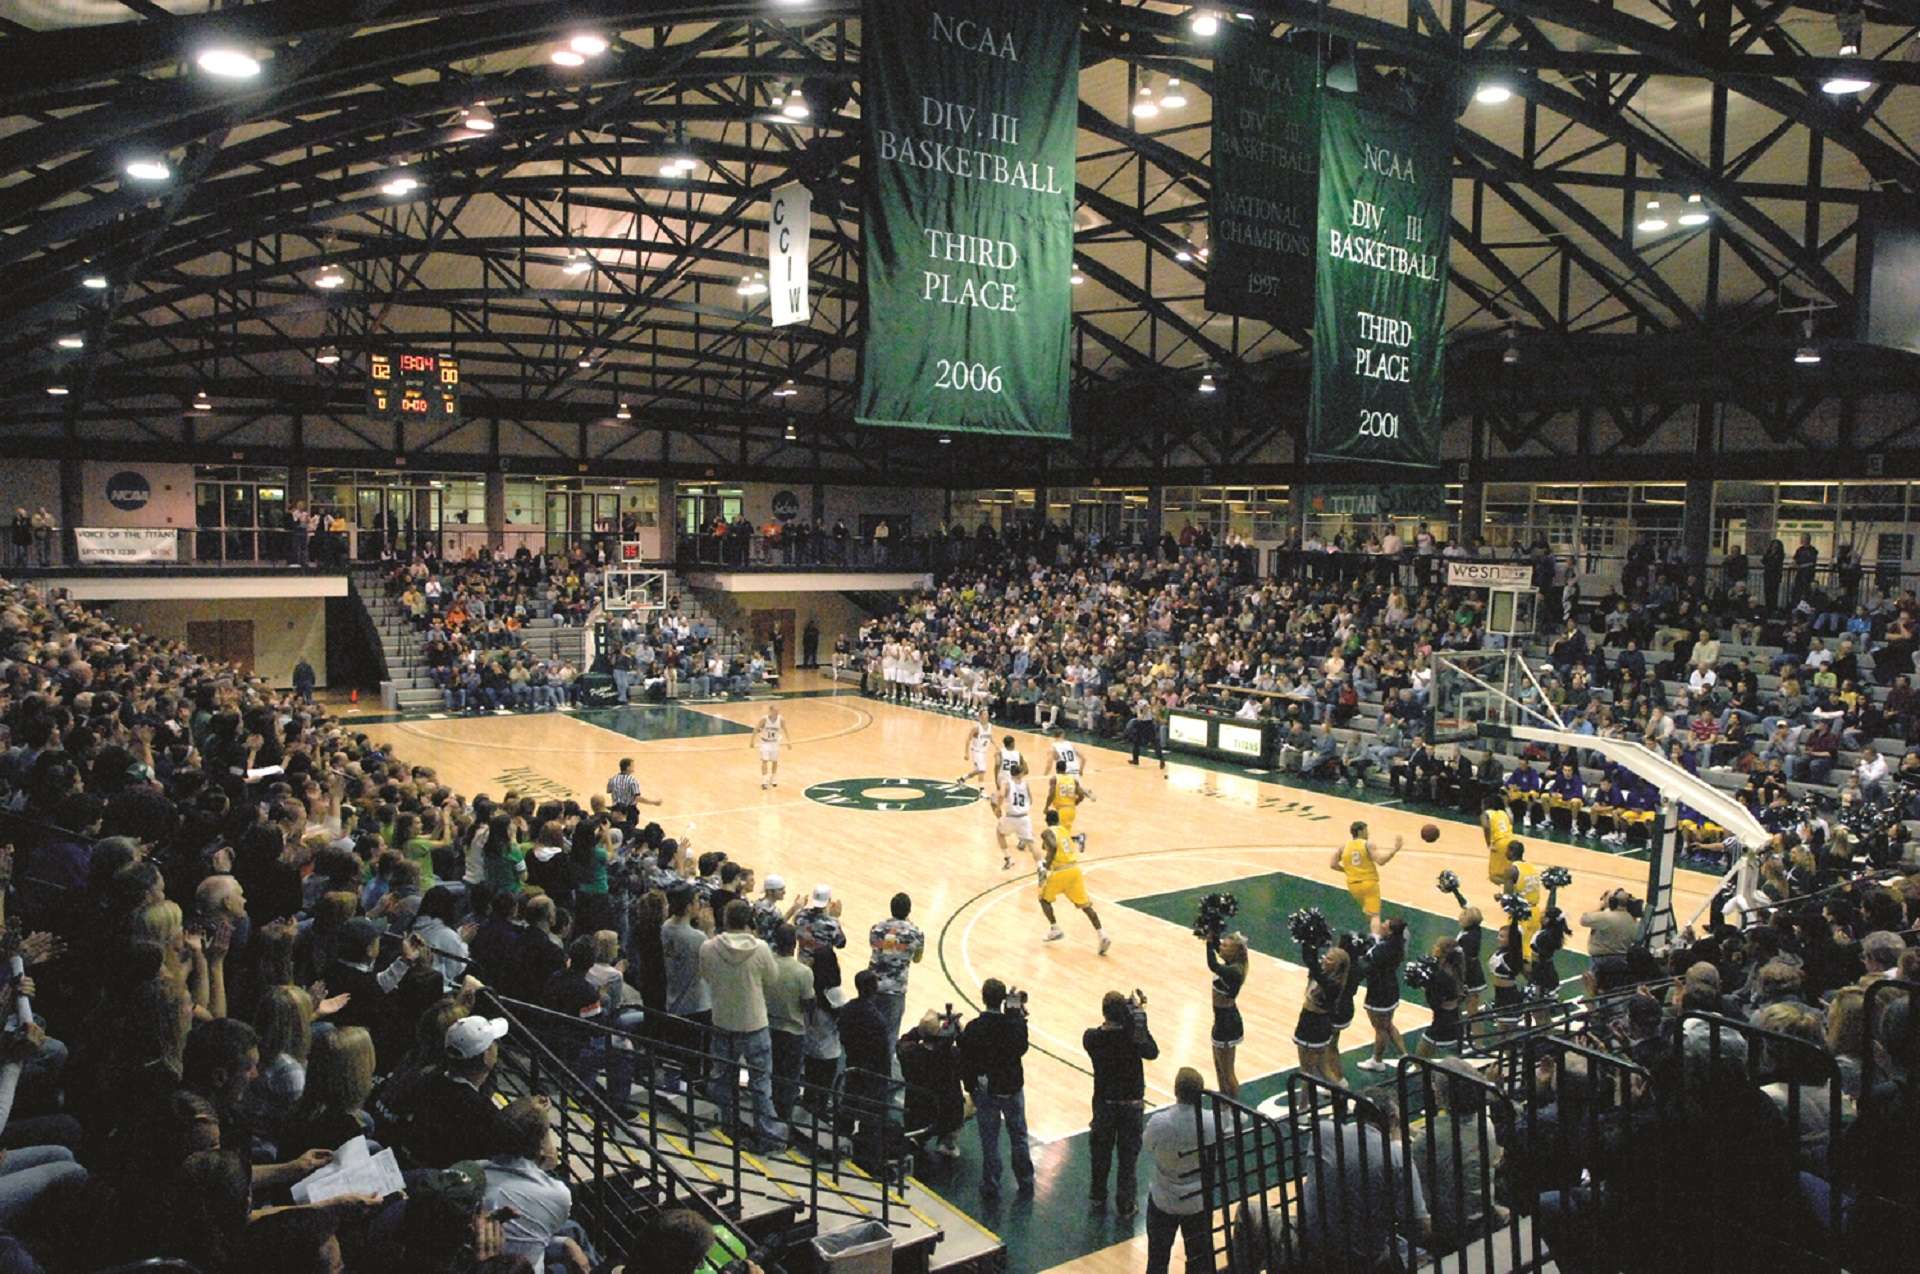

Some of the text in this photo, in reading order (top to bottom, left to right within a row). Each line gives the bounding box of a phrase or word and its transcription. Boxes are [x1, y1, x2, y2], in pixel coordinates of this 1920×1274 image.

[932, 12, 1018, 62] NCAA
[1249, 63, 1294, 97] NCAA
[991, 112, 1019, 146] III
[878, 130, 1063, 195] BASKETBALL
[1221, 131, 1317, 174] BASKETBALL
[1363, 143, 1416, 184] NCAA
[1224, 191, 1301, 229] NATIONAL
[1405, 214, 1422, 243] III
[924, 228, 1018, 271] THIRD
[1220, 218, 1310, 257] CHAMPIONS
[1330, 229, 1440, 281] BASKETBALL
[923, 271, 1017, 312] PLACE
[1248, 272, 1281, 297] 1997
[1357, 311, 1412, 348] THIRD
[935, 359, 1003, 394] 2006
[1355, 347, 1411, 383] PLACE
[1359, 409, 1399, 439] 2001
[1452, 565, 1500, 579] wesn
[1061, 749, 1075, 762] 10
